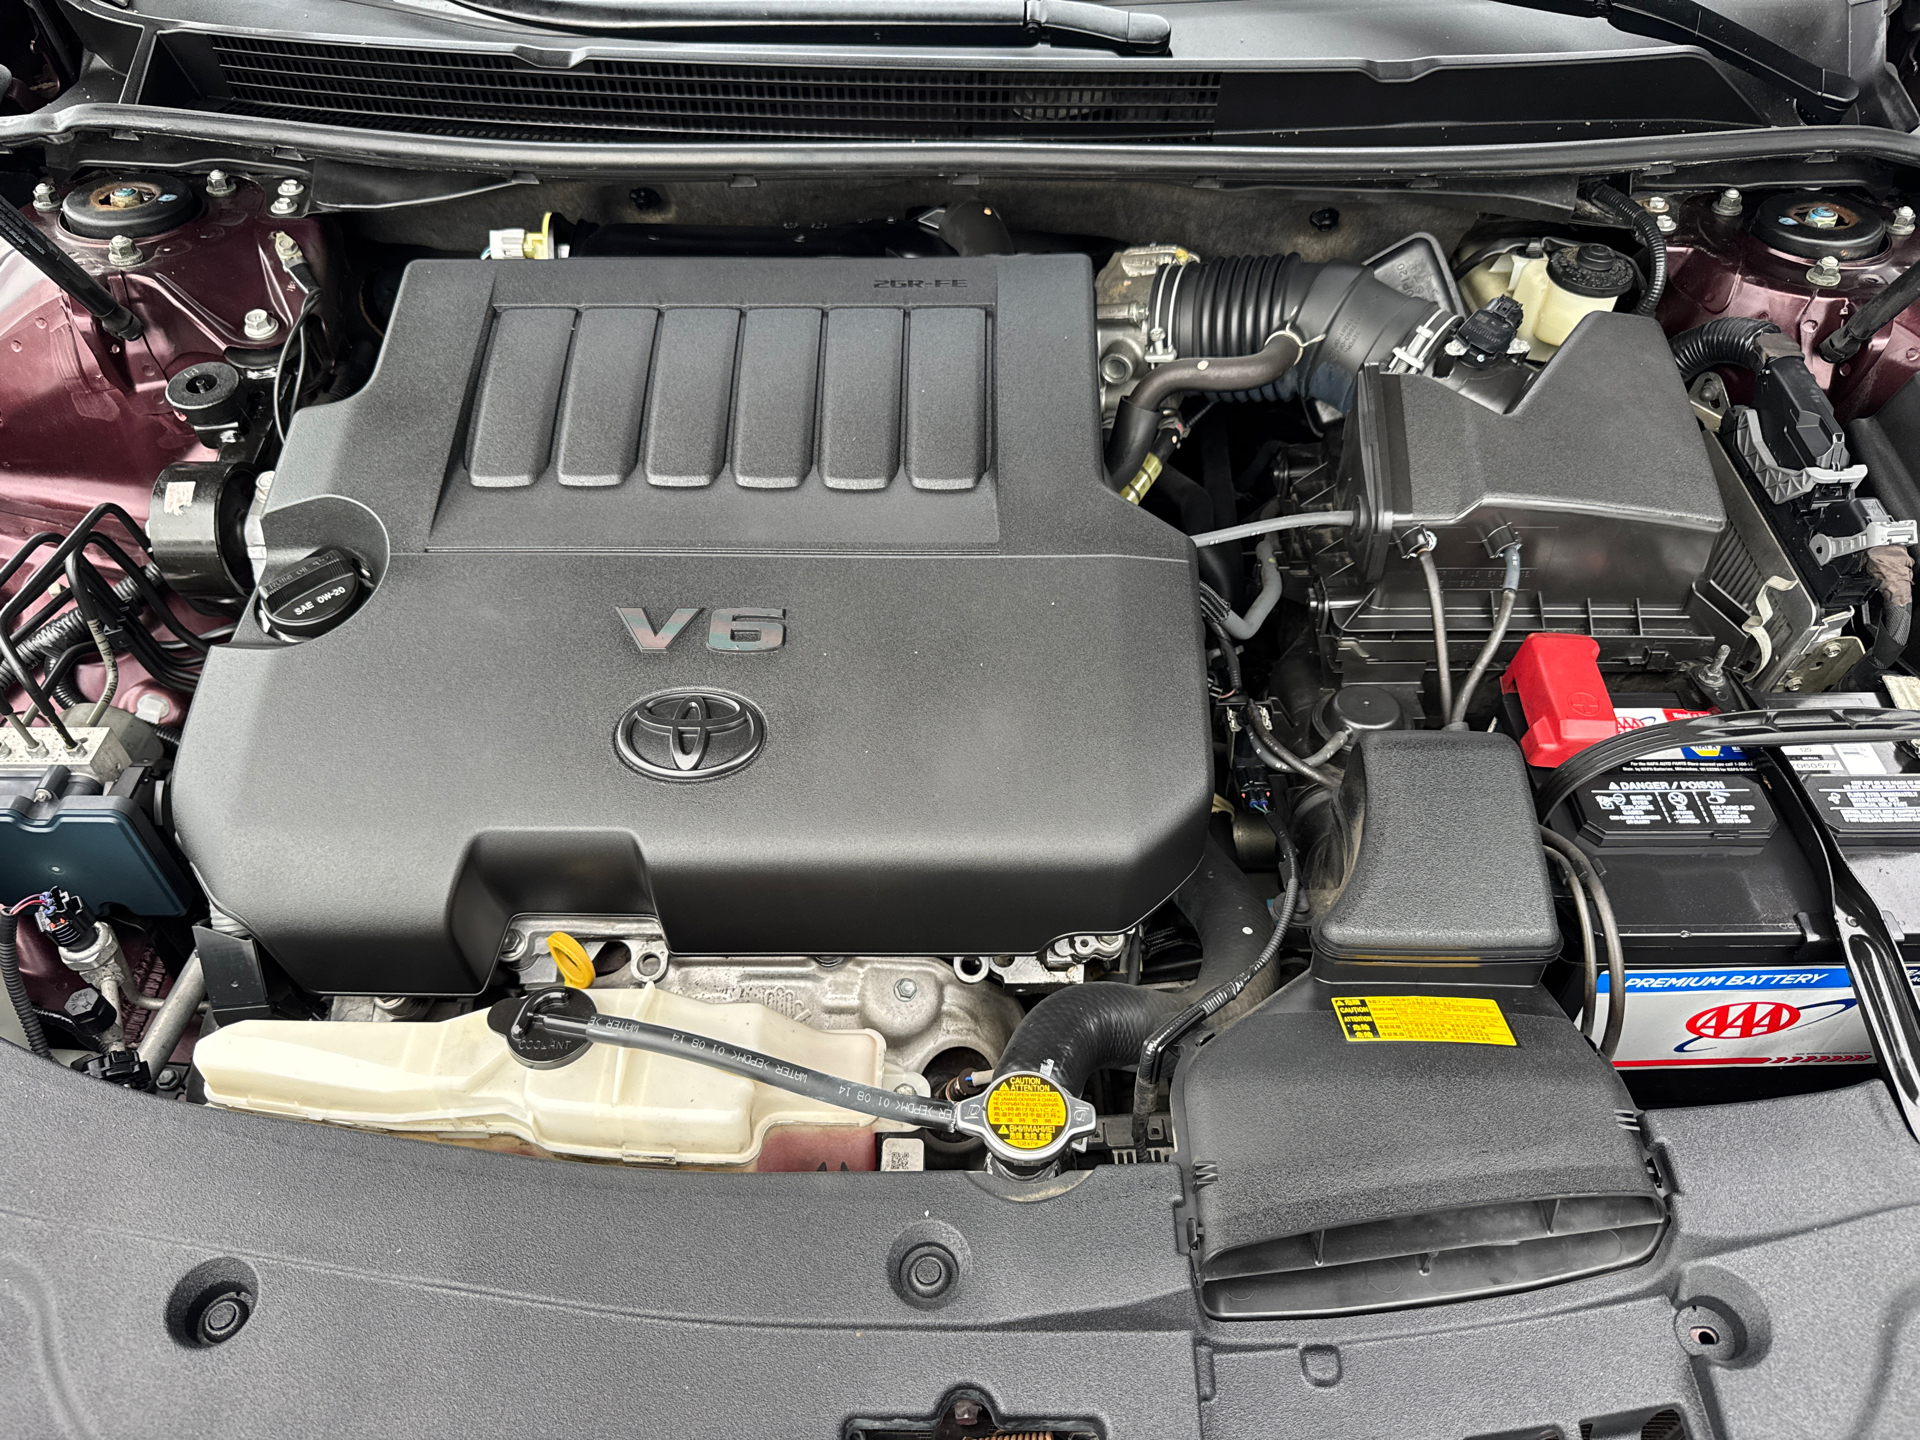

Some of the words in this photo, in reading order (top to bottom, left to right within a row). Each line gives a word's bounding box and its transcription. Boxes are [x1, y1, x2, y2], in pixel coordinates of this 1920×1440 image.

[874, 280, 968, 288] 2GR-FE
[293, 600, 315, 616] SAE
[316, 586, 346, 604] 0W-20
[616, 606, 787, 653] V6
[1620, 782, 1670, 790] DANGER
[1680, 781, 1725, 789] POISON
[1625, 975, 1724, 988] PREMIUM
[1726, 974, 1829, 986] BATTERY
[606, 1018, 640, 1034] WATER
[1693, 1003, 1792, 1037] AAA
[672, 1032, 685, 1044] 14
[518, 1040, 572, 1050] COOLANT
[775, 1064, 808, 1084] WATER
[838, 1085, 850, 1097] 14
[878, 1096, 890, 1108] 01
[1009, 1125, 1055, 1133] ВНИМАНИЕ!
